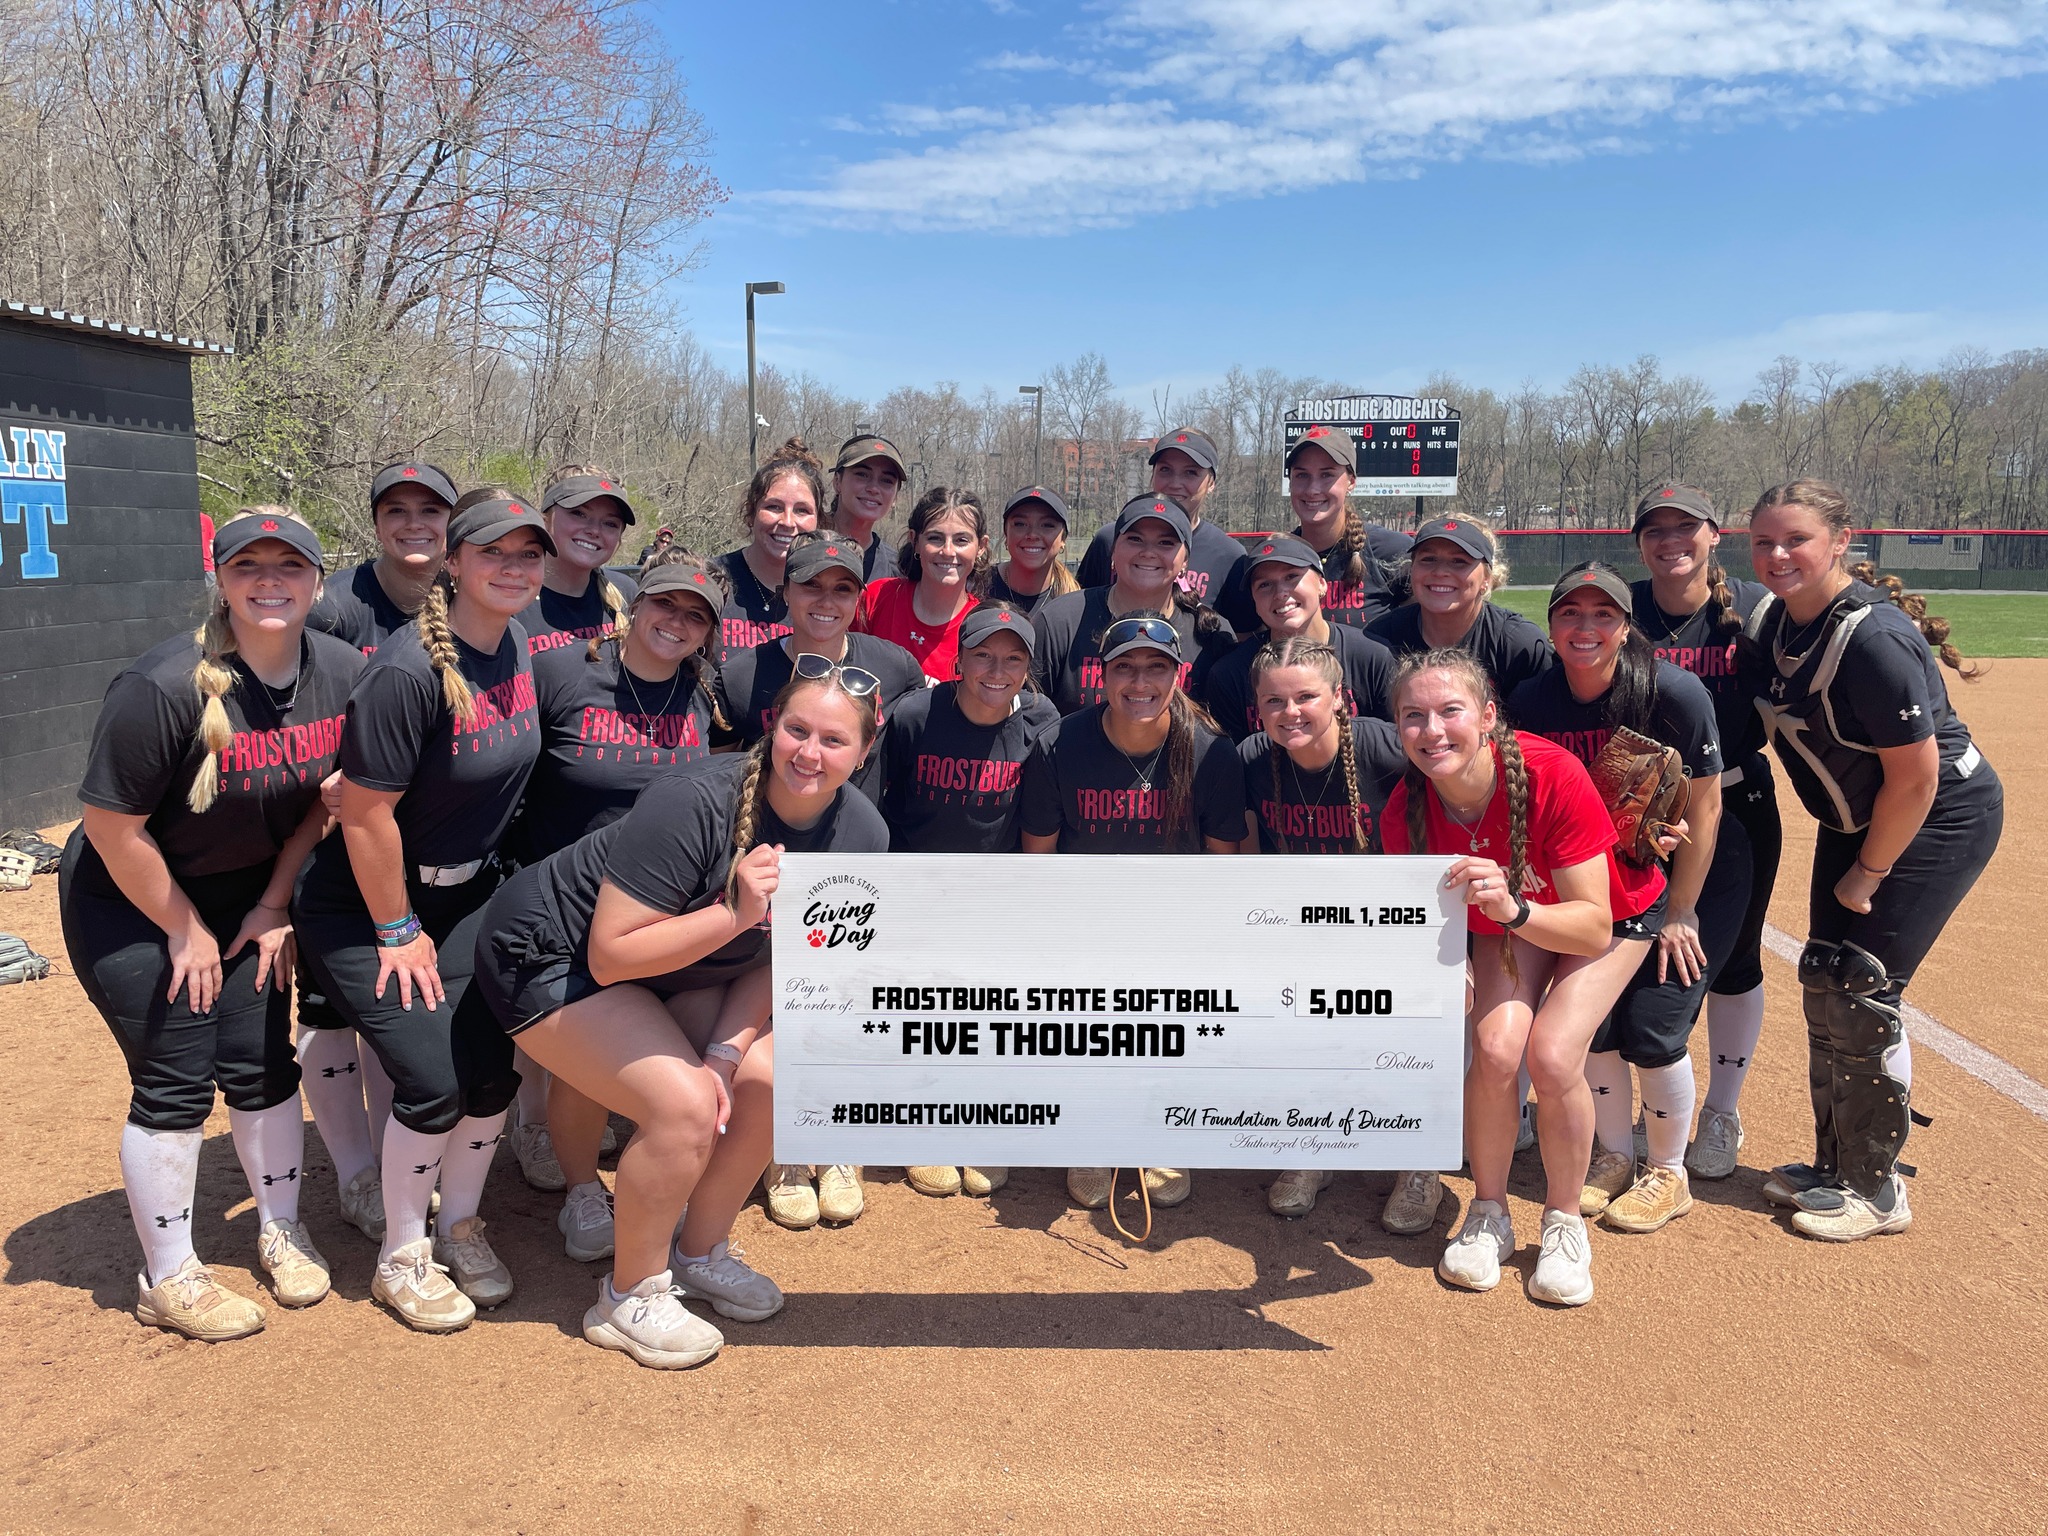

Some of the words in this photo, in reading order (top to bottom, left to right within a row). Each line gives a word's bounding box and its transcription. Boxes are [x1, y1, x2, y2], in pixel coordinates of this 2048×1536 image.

[1298, 399, 1378, 420] FROSTBURG
[1383, 398, 1447, 420] BOBCATS
[1341, 427, 1363, 436] RIKE
[1390, 426, 1407, 436] OUT
[1432, 426, 1446, 436] H/E
[1361, 441, 1367, 449] 5
[1371, 441, 1376, 449] 6
[1383, 441, 1388, 449] 7
[1392, 441, 1397, 449] 8
[1403, 441, 1420, 449] RUNS
[1427, 441, 1441, 449] HITS
[1445, 441, 1457, 449] ERR
[580, 706, 700, 747] FROSTBURG
[917, 754, 1024, 792] FROSTBUR
[809, 875, 855, 897] FROSTBURG
[857, 878, 879, 897] STATE
[803, 900, 876, 926] Giving
[1245, 908, 1289, 925] Date:
[1301, 906, 1355, 924] APRIL
[1360, 907, 1374, 927] 1,
[1379, 907, 1426, 925] 2025
[826, 923, 878, 951] Day
[785, 977, 815, 999] Pay
[818, 984, 829, 993] to
[872, 986, 1019, 1011] FROSTBURG
[1027, 988, 1106, 1011] STATE
[1113, 988, 1239, 1012] SOFTBALL
[784, 998, 802, 1010] the
[804, 998, 837, 1010] order
[837, 998, 854, 1015] of:
[1281, 987, 1294, 1008] $
[1310, 989, 1392, 1019] 5,000
[902, 1022, 978, 1055] FIVE
[990, 1022, 1185, 1057] THOUSAND
[1374, 1051, 1435, 1070] Dollars
[794, 1109, 829, 1126] For:
[831, 1103, 1060, 1125] #BOBCATGIVINGDAY
[1164, 1106, 1197, 1127] FSU
[1201, 1107, 1282, 1127] Foundation
[1286, 1108, 1334, 1128] Board
[1338, 1107, 1354, 1136] of
[1358, 1109, 1422, 1130] Directors
[1229, 1132, 1299, 1154] Authorized
[1300, 1134, 1360, 1155] Signature
